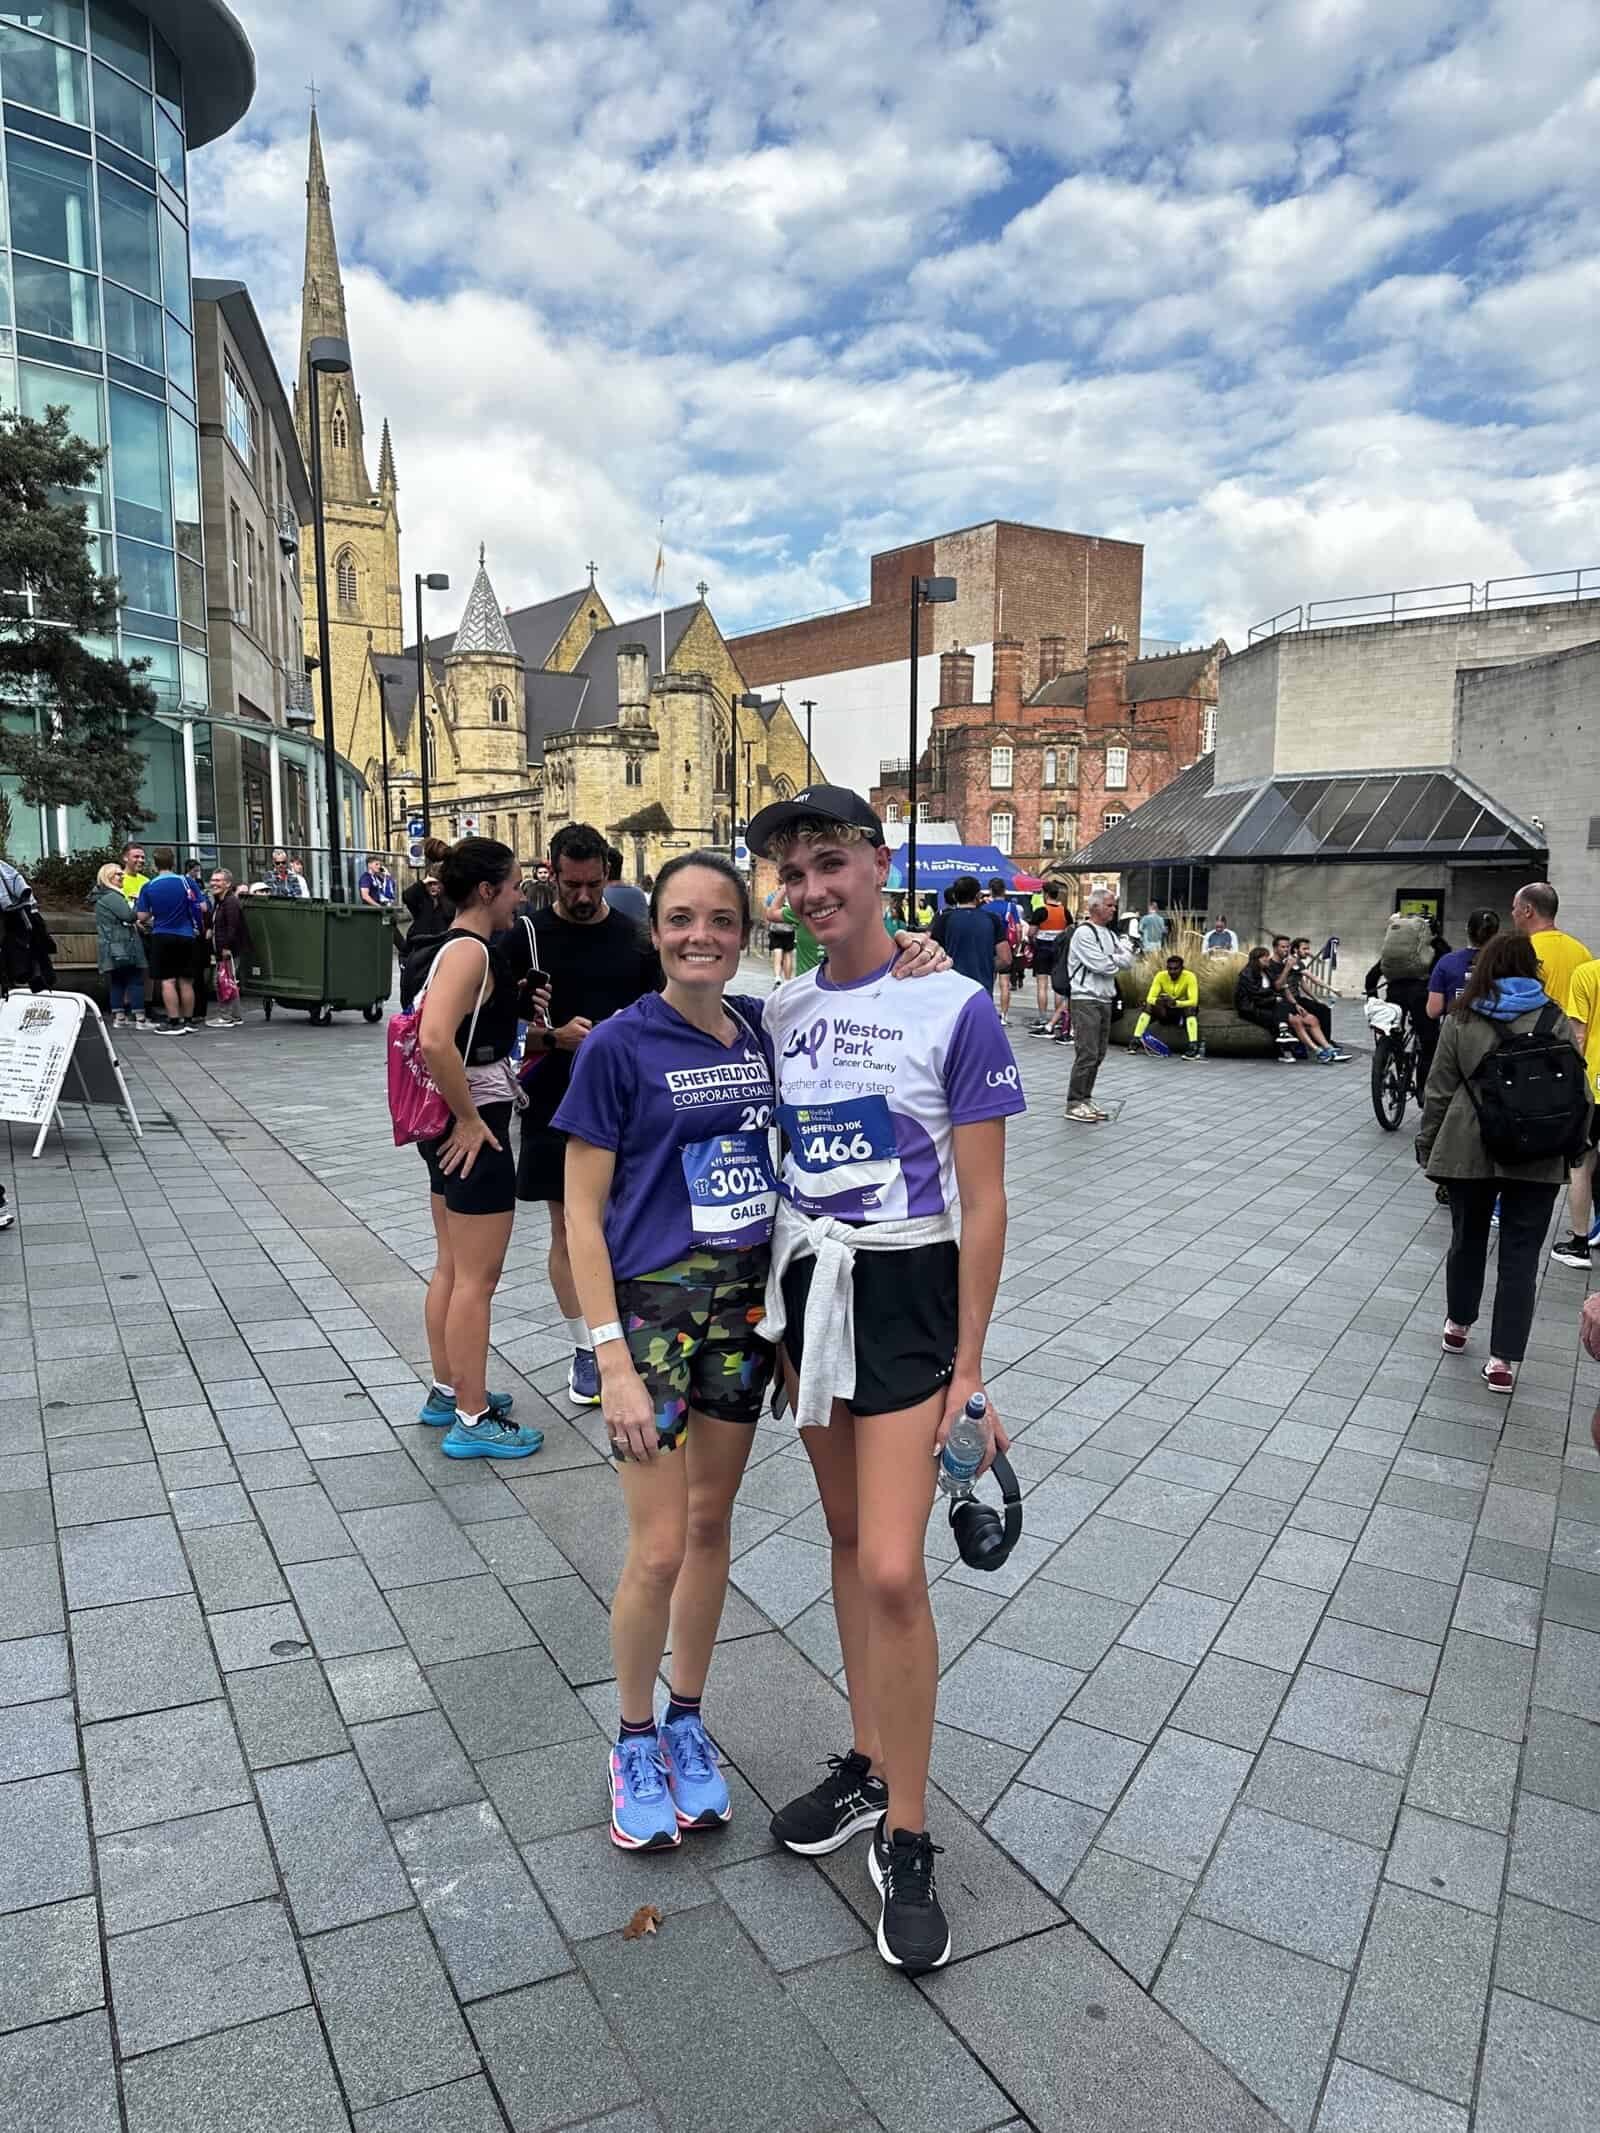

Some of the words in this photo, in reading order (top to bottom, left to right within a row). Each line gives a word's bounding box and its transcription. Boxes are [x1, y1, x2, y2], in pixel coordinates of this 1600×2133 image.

[931, 863, 955, 871] RUN
[956, 864, 977, 873] FOR
[979, 865, 999, 873] ALL
[833, 1018, 904, 1041] Weston
[833, 1037, 875, 1057] Park
[832, 1057, 861, 1068] Cancer
[862, 1059, 897, 1073] Charity
[672, 1087, 740, 1106] CORPORATE
[819, 1079, 832, 1089] at
[833, 1079, 865, 1092] every
[865, 1081, 895, 1096] step
[845, 1120, 863, 1131] 10K
[711, 1167, 768, 1198] 3025
[730, 1203, 767, 1221] GALER
